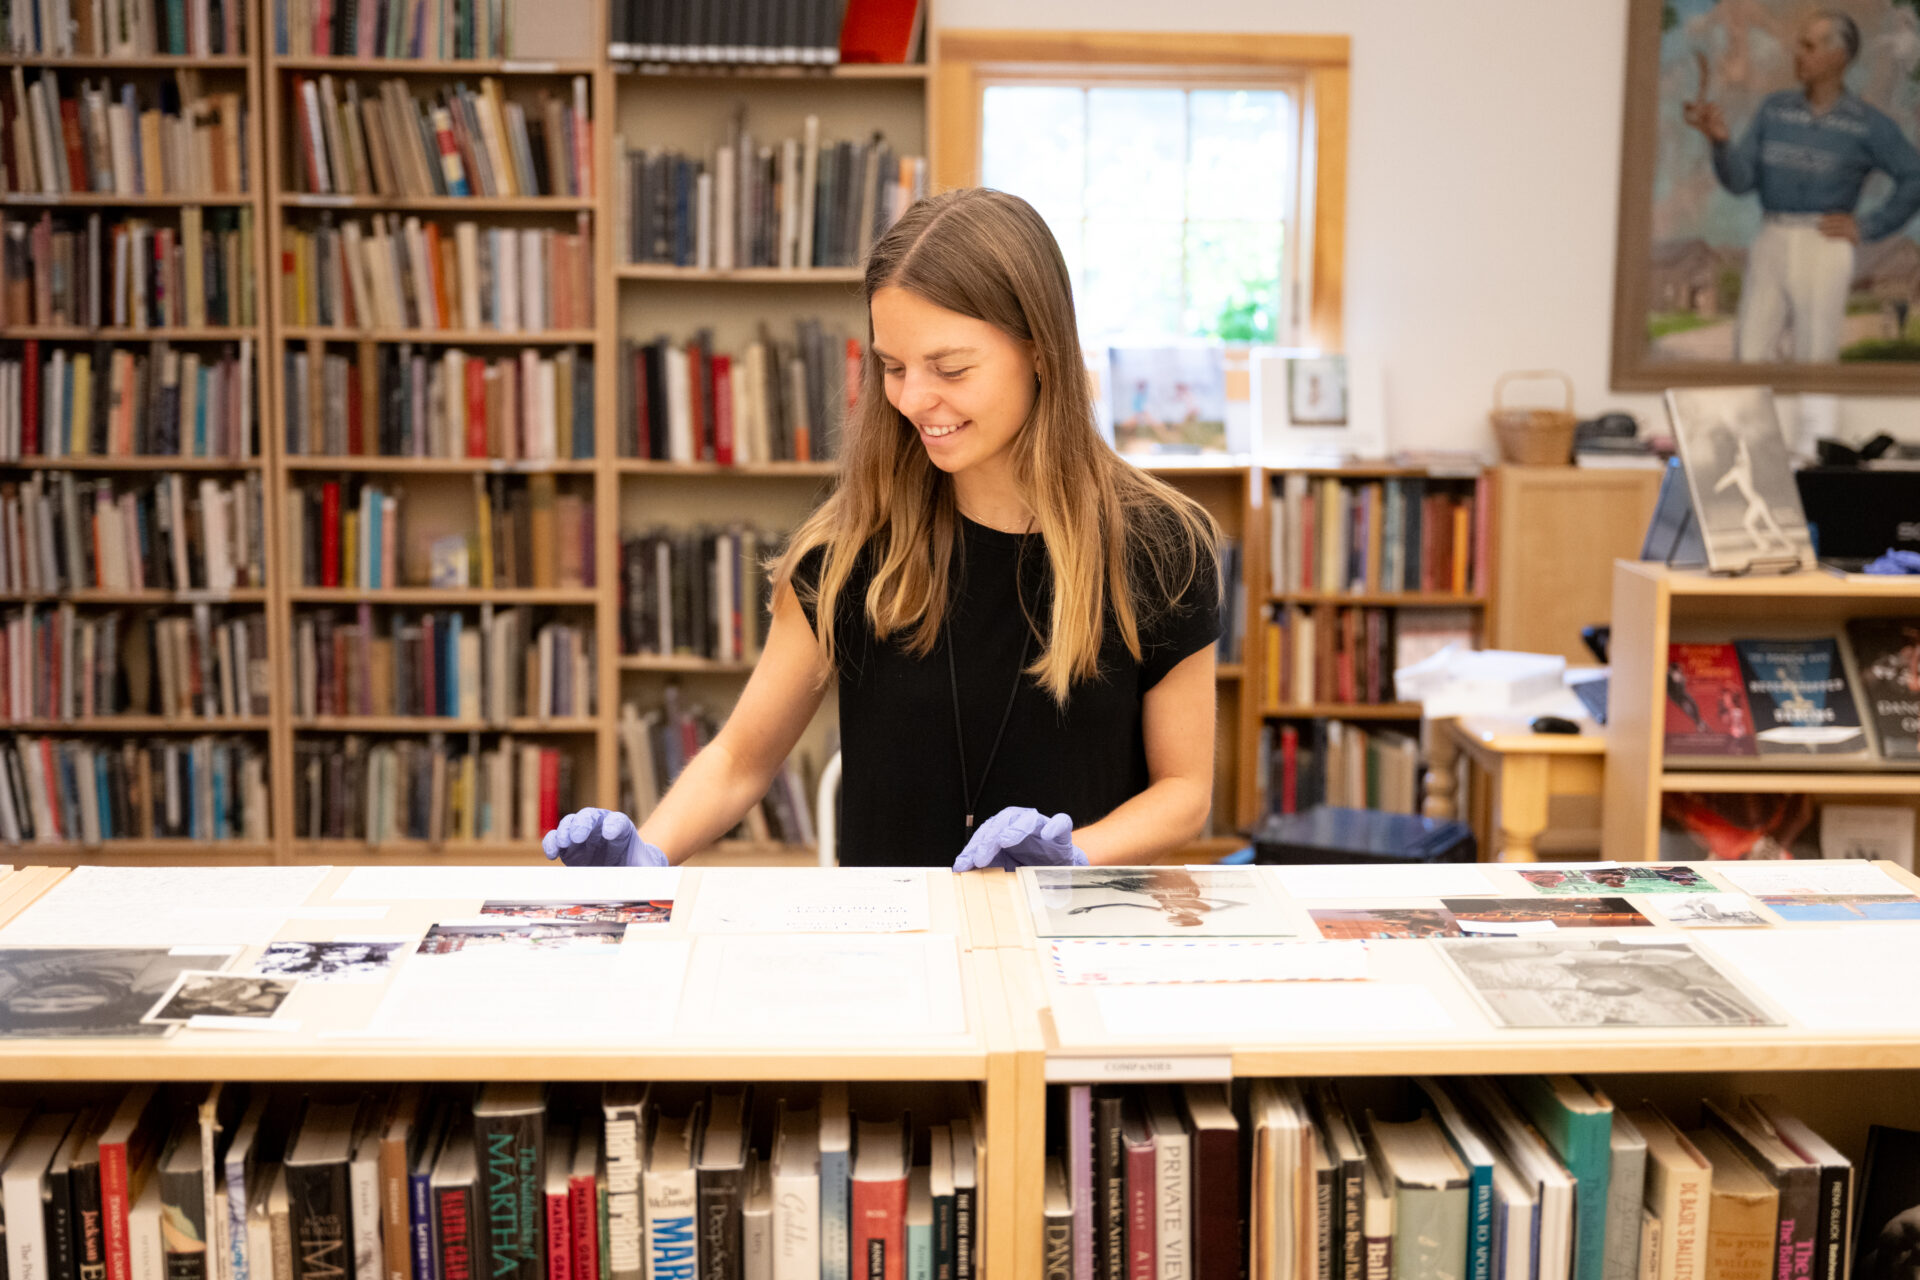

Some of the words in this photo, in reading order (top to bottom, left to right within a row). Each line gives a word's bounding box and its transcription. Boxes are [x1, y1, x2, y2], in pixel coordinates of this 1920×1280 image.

[1104, 1061, 1173, 1073] COMPANIES
[520, 1146, 537, 1171] The
[1164, 1145, 1182, 1231] PRIVATE
[1345, 1176, 1362, 1198] Life
[1346, 1199, 1360, 1210] at
[1477, 1184, 1491, 1221] HYMN
[1831, 1181, 1842, 1207] RENA
[488, 1133, 519, 1277] MARTHA
[521, 1175, 538, 1242] Notebooks
[576, 1187, 587, 1239] MARTHA
[1346, 1212, 1361, 1230] the
[1677, 1199, 1698, 1238] BASIL'S
[81, 1210, 99, 1261] Jackson
[552, 1197, 563, 1249] MARTHA
[777, 1193, 808, 1257] Goddess
[1476, 1224, 1489, 1242] TO
[1780, 1219, 1795, 1243] The
[21, 1243, 32, 1261] The
[301, 1239, 345, 1280] M
[521, 1245, 538, 1259] of
[652, 1216, 696, 1280] MAR
[872, 1241, 883, 1275] ANNA
[1343, 1231, 1362, 1262] Royal
[1795, 1238, 1814, 1274] The
